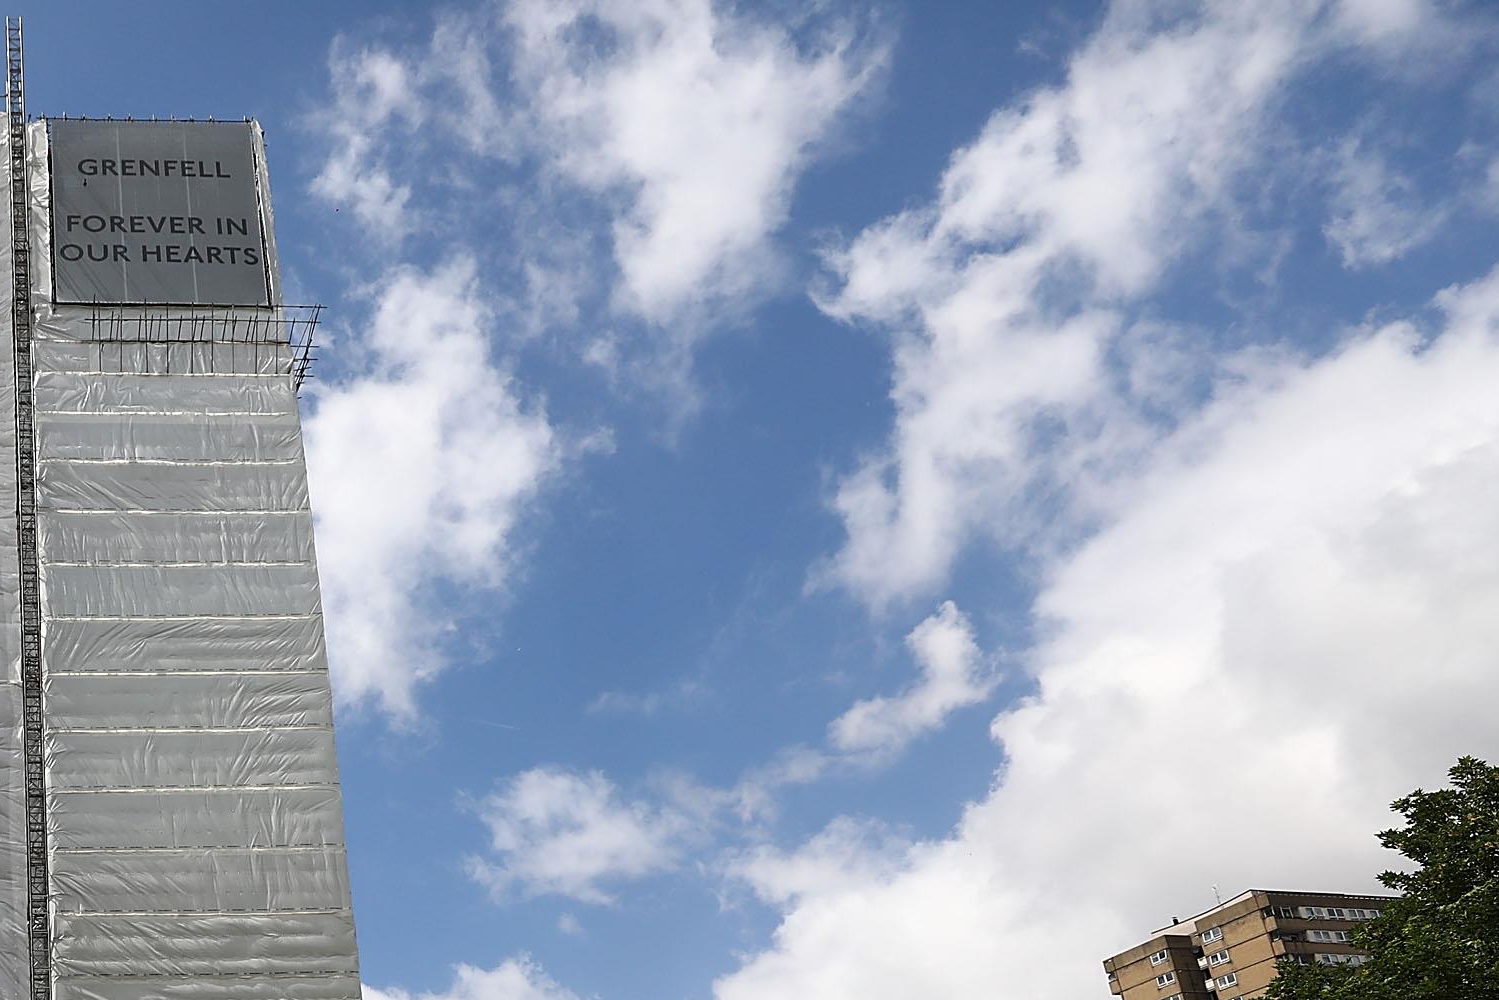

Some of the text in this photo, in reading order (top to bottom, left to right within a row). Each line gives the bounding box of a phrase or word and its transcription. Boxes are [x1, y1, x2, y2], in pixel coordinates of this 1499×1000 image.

[77, 158, 231, 179] GRENFELL
[66, 214, 248, 236] FOREVER IN
[59, 243, 260, 266] OUR HEARTS
